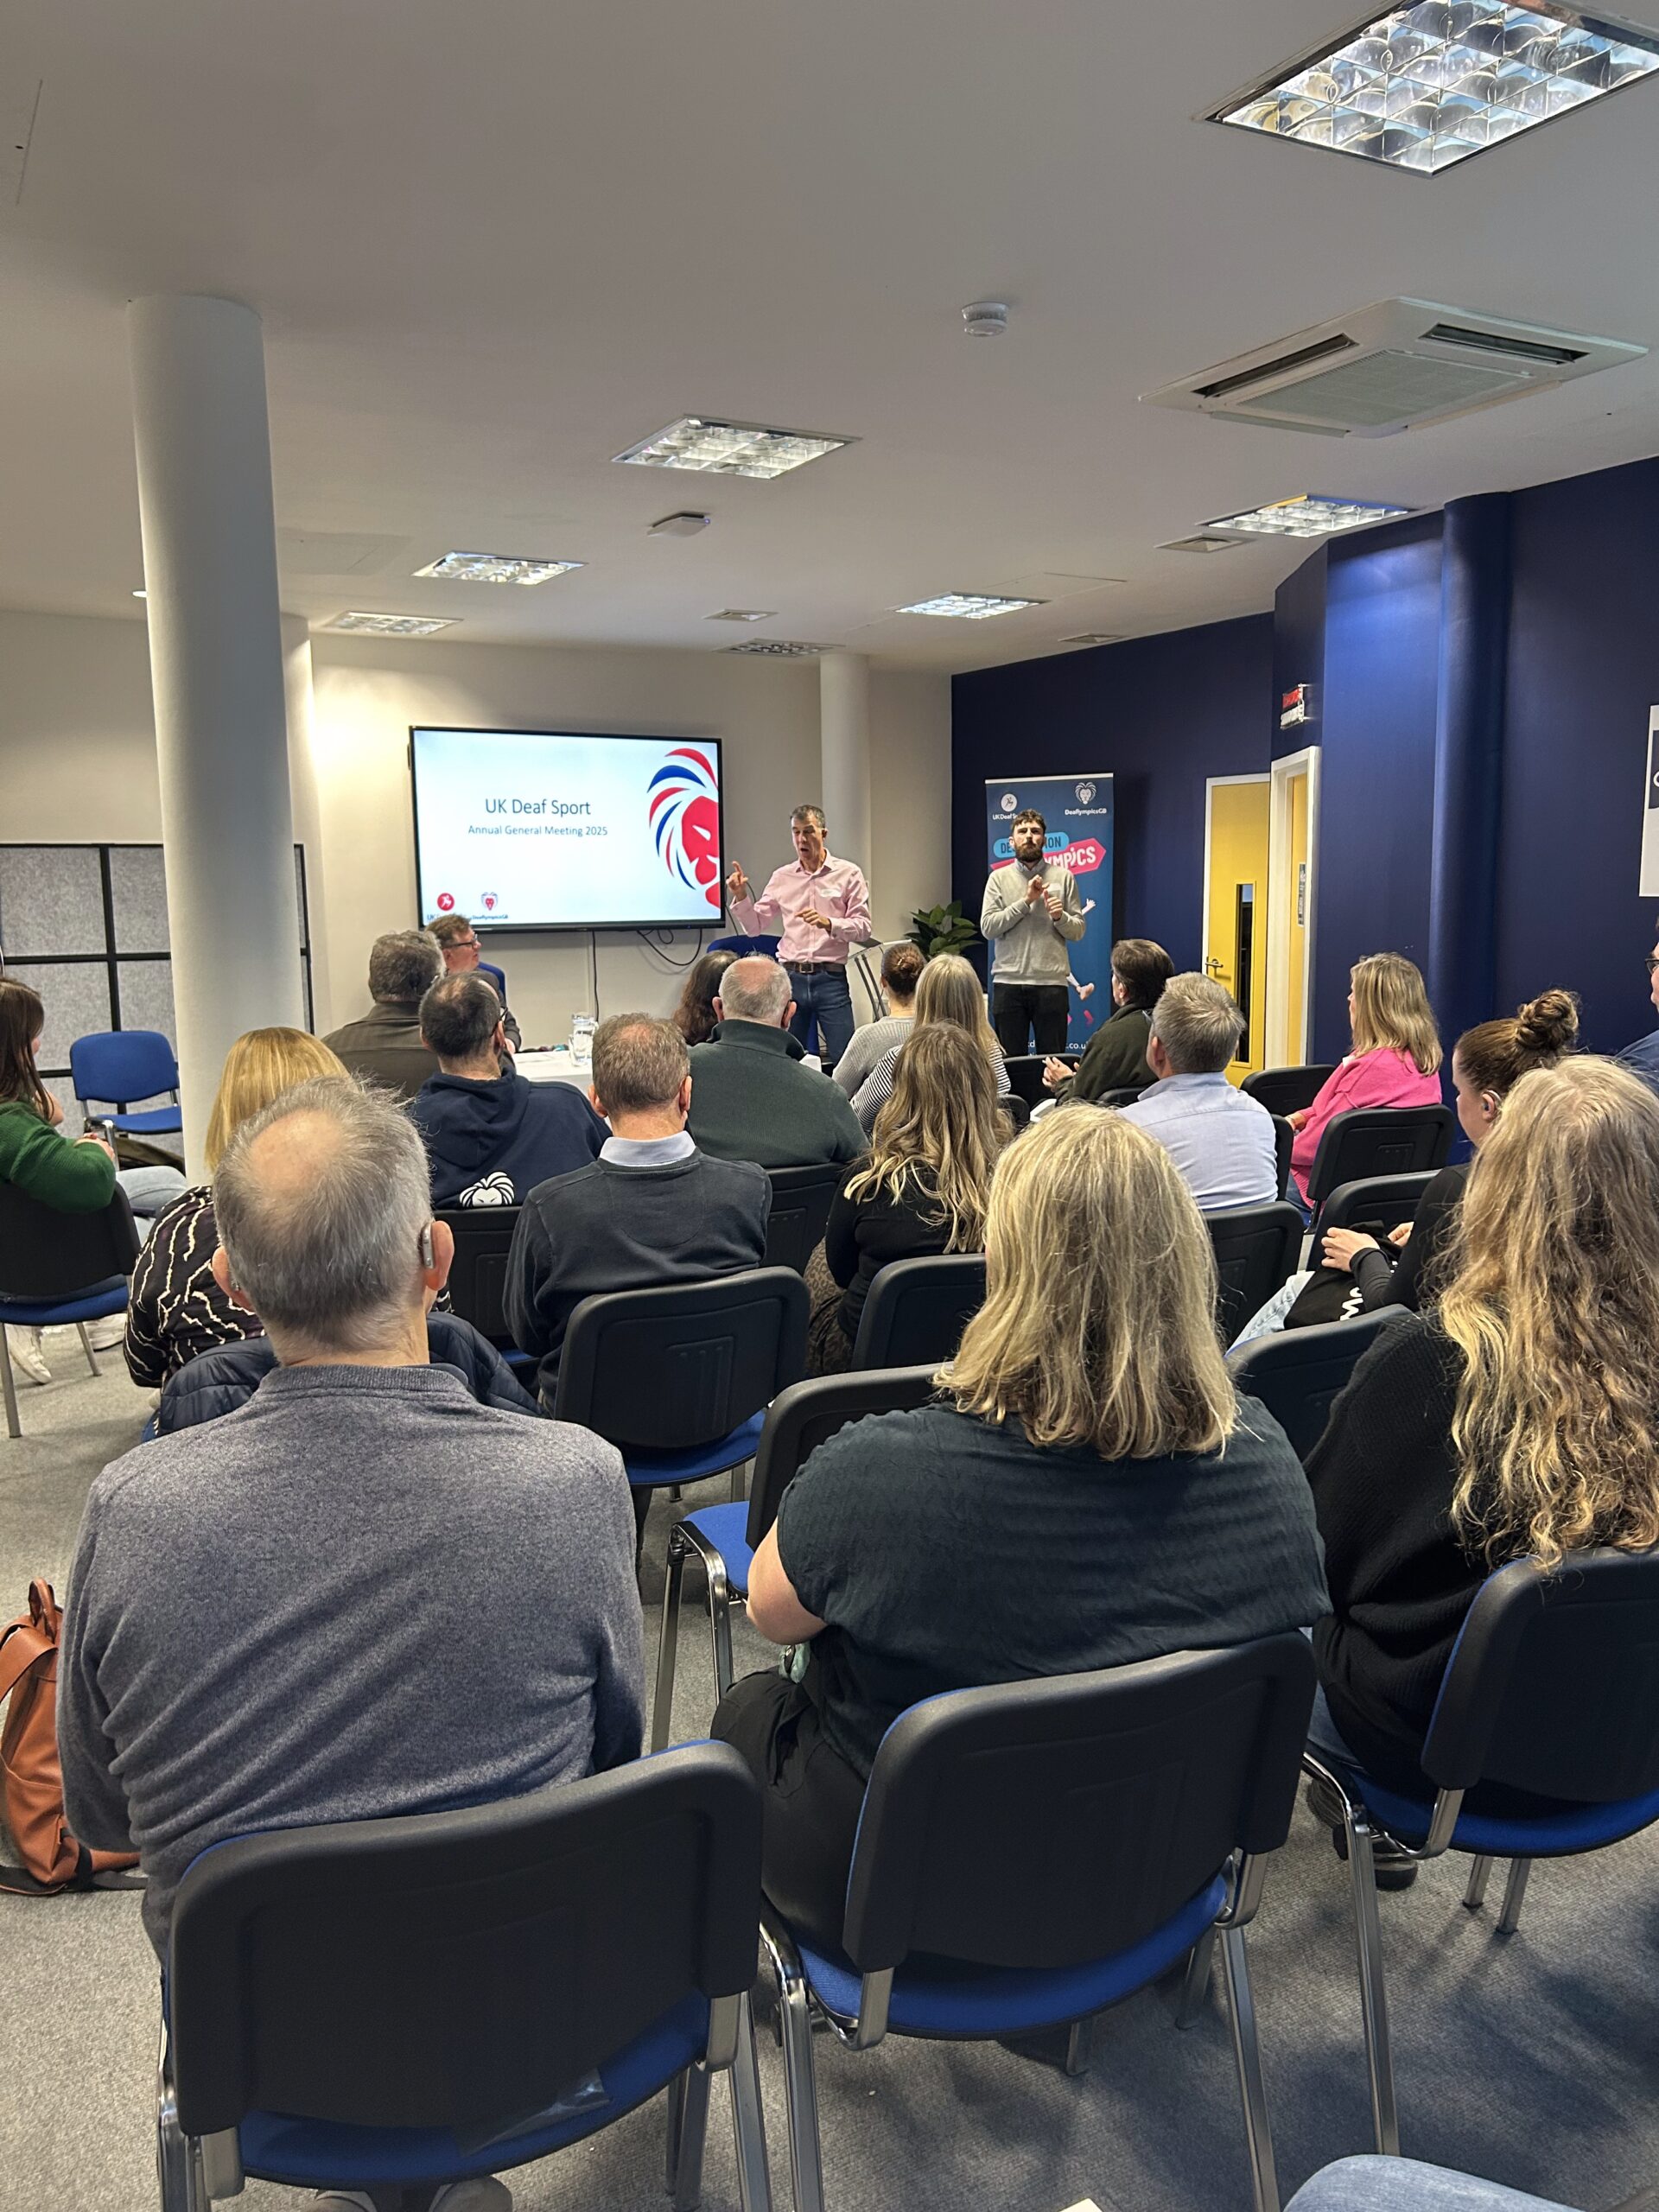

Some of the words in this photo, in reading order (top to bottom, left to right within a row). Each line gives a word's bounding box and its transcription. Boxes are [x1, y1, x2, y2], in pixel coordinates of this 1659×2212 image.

[486, 798, 507, 814] UK
[512, 798, 547, 814] Deaf
[551, 799, 591, 817] Sport
[468, 825, 502, 835] Annual
[505, 825, 542, 835] General
[544, 826, 582, 836] Meeting
[585, 826, 607, 836] 2025
